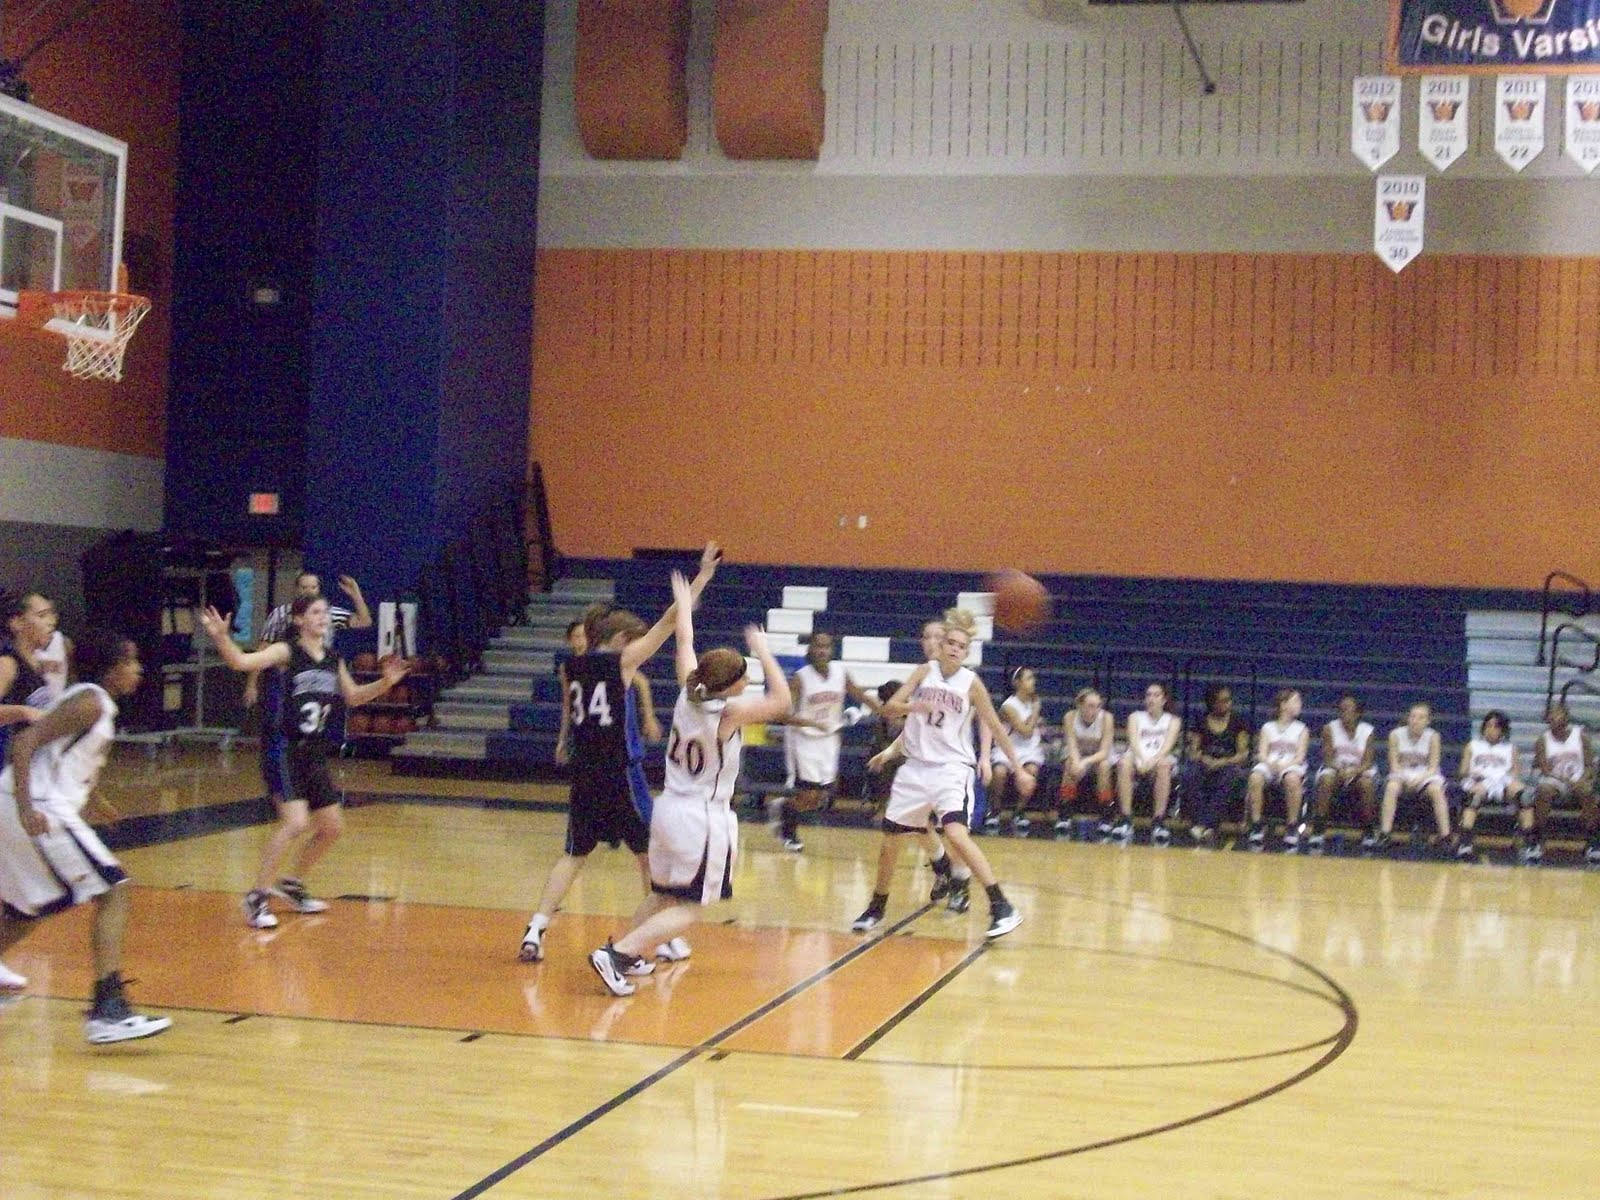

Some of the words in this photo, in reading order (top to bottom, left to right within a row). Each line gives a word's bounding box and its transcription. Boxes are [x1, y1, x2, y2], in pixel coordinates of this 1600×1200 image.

[1422, 13, 1500, 57] Girls
[1512, 18, 1600, 59] Varsi
[1428, 81, 1461, 94] 2011
[1504, 81, 1537, 94] 2011
[1383, 182, 1420, 194] 2010
[570, 680, 613, 726] 34
[926, 710, 945, 728] 12
[668, 726, 705, 775] 20
